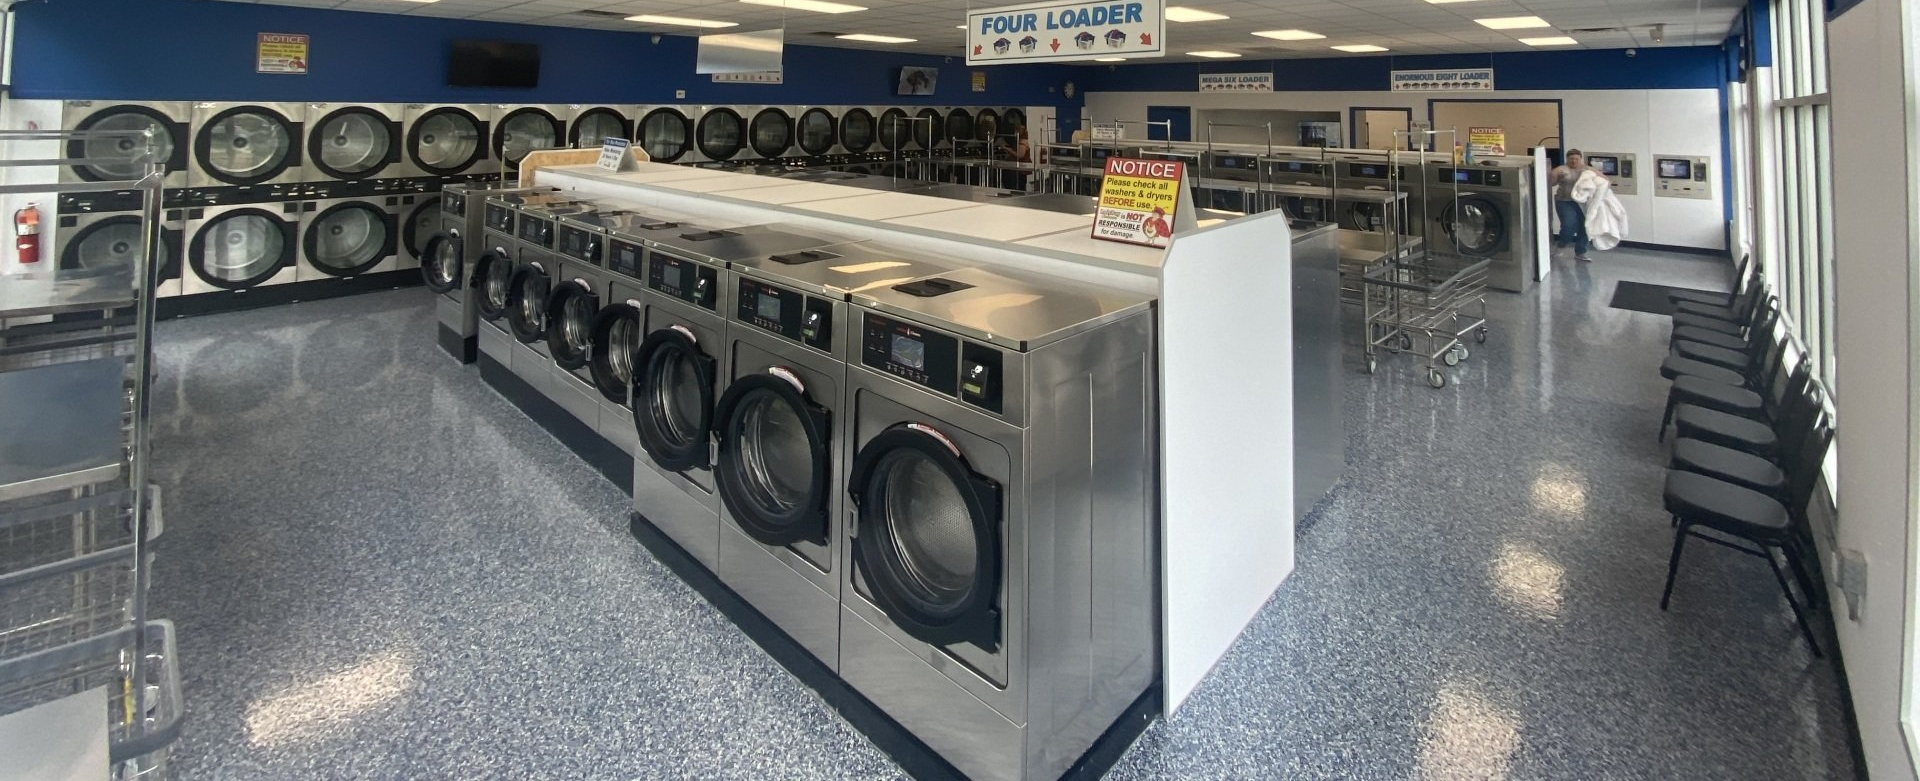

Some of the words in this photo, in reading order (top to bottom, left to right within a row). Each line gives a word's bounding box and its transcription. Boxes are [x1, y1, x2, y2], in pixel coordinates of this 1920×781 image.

[981, 13, 1037, 35] FOUR
[1046, 3, 1142, 30] LOADER
[263, 35, 305, 43] NOTICE
[1395, 73, 1435, 82] ENORMOUS
[1435, 73, 1458, 81] EIGHT
[1460, 72, 1489, 80] LOADER
[1110, 161, 1175, 177] NOTICE
[1107, 177, 1131, 186] Please
[1133, 180, 1156, 188] check
[1105, 188, 1135, 197] washers
[1147, 191, 1172, 201] dryers
[1103, 197, 1135, 207] BEFORE
[1126, 212, 1145, 221] NOT
[1099, 220, 1140, 230] RESPONSIBLE
